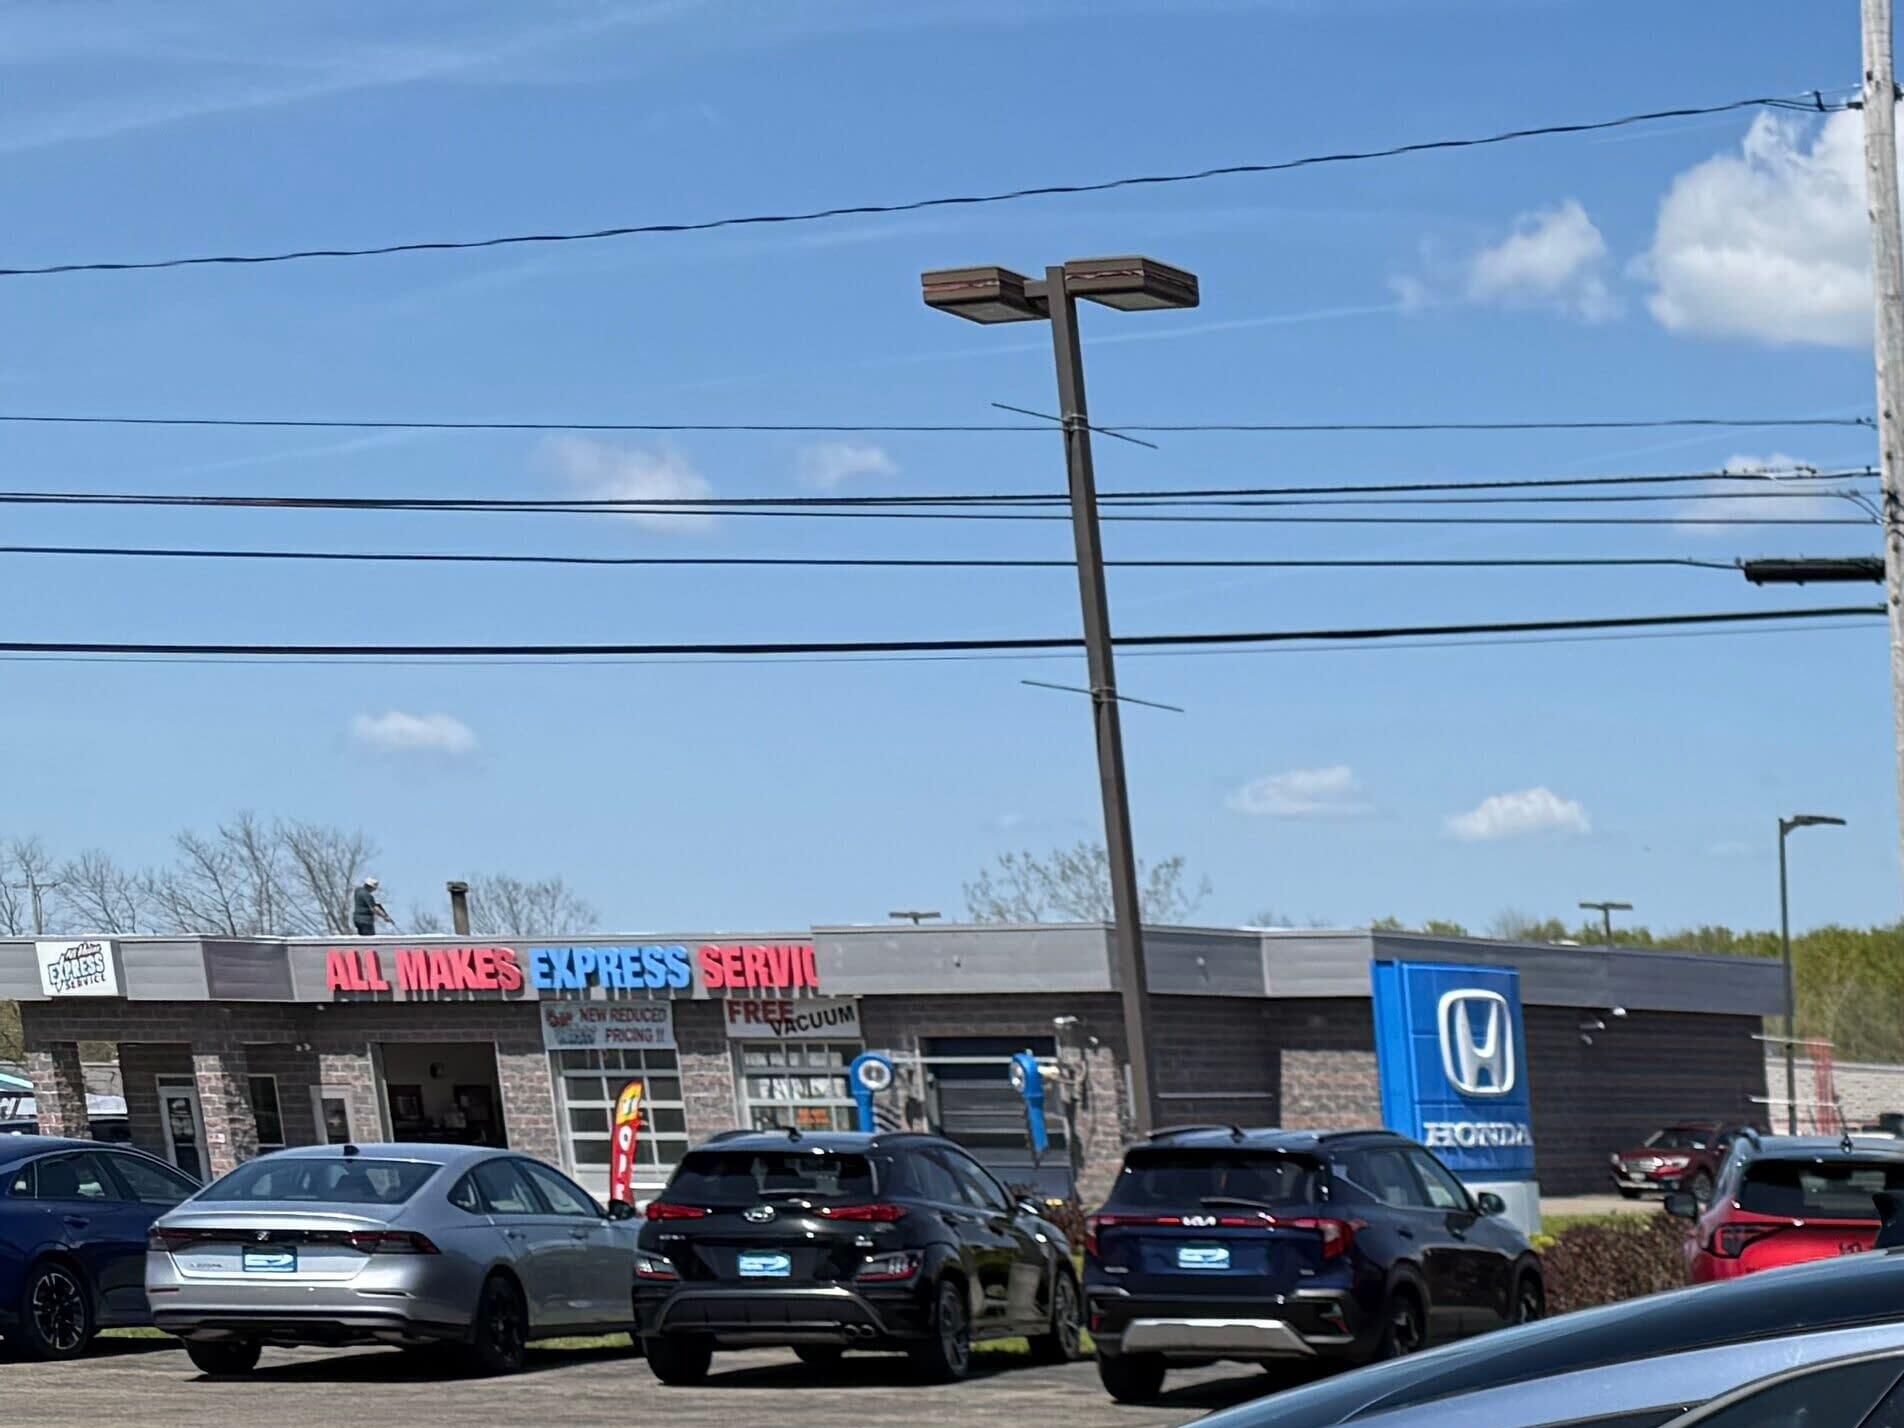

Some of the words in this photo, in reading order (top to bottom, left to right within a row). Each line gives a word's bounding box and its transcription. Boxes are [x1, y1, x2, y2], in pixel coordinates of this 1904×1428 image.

[48, 951, 106, 992] EXPRESS
[326, 948, 388, 992] ALL
[394, 947, 522, 991] MAKES
[529, 946, 690, 988] EXPRESS
[697, 946, 818, 987] SERVIC
[580, 1007, 607, 1022] NEW
[610, 1007, 667, 1023] REDUCED
[727, 1000, 794, 1024] FREE
[769, 1005, 856, 1036] VACUUM
[605, 1028, 653, 1042] PRICING
[1422, 1121, 1535, 1148] HONDA
